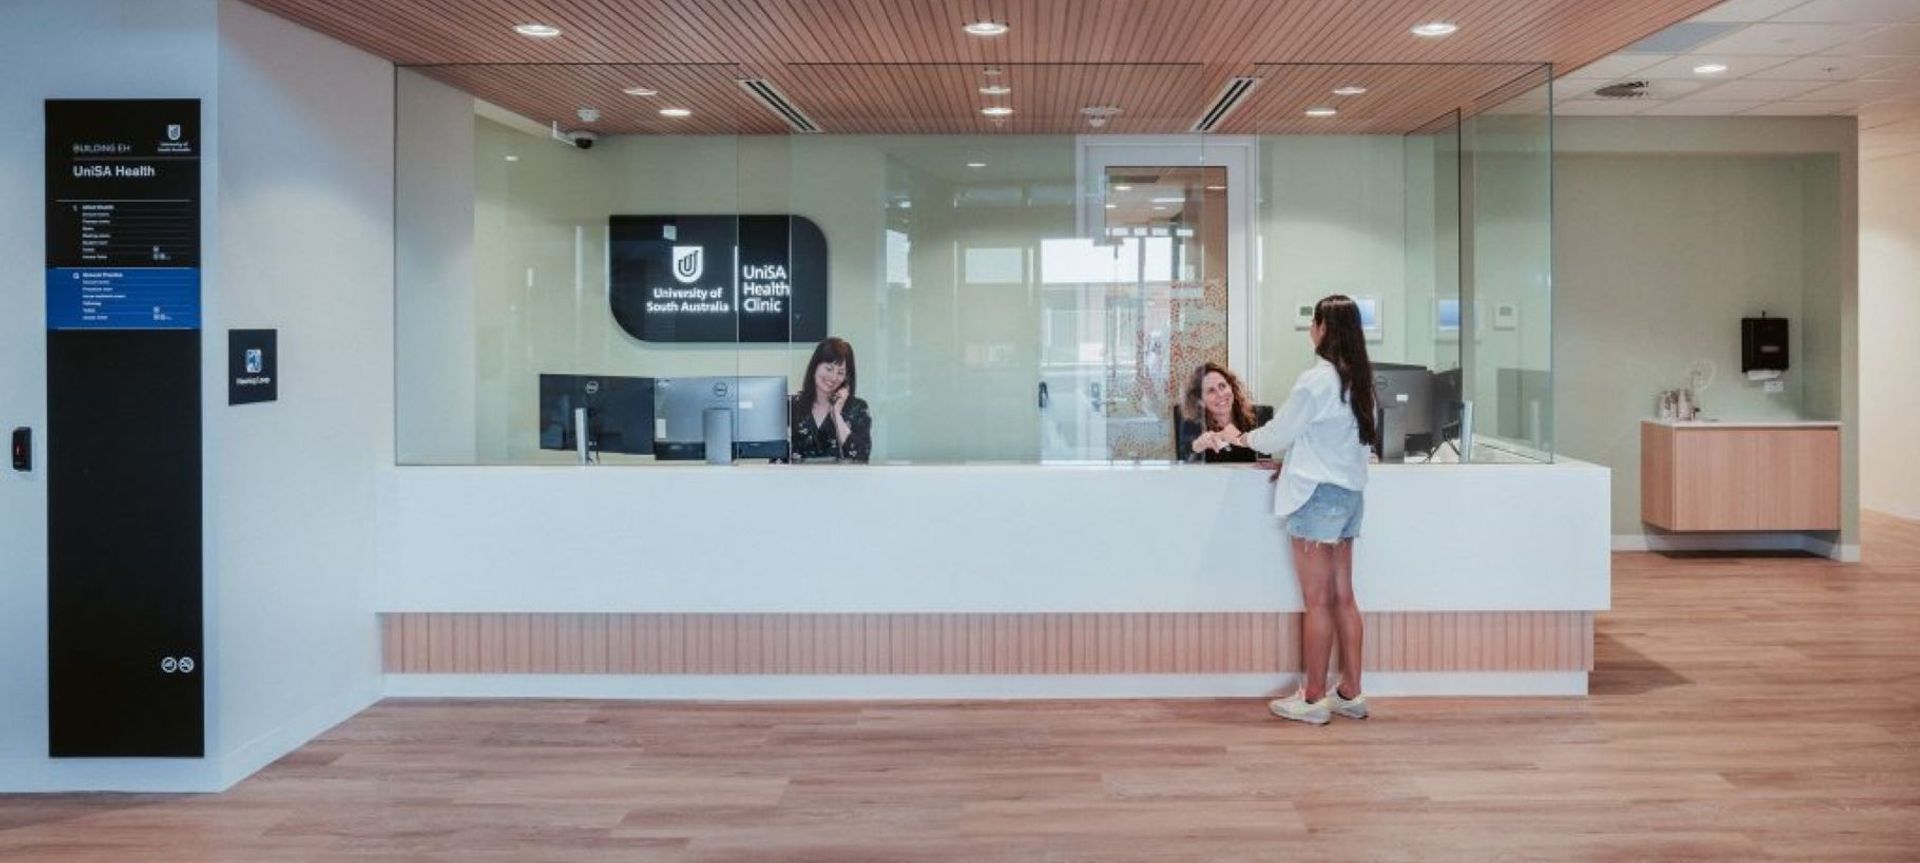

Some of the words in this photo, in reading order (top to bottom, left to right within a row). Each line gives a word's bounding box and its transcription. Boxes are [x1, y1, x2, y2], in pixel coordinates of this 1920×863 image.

[73, 143, 115, 153] BUILDING
[118, 143, 131, 153] EH
[73, 165, 112, 177] UniSA
[115, 165, 155, 177] Health
[743, 264, 787, 280] UniSA
[653, 287, 707, 300] University
[709, 287, 723, 298] of
[743, 281, 790, 296] Health
[646, 301, 678, 312] South
[680, 301, 730, 312] Australia
[743, 298, 782, 313] Clinic
